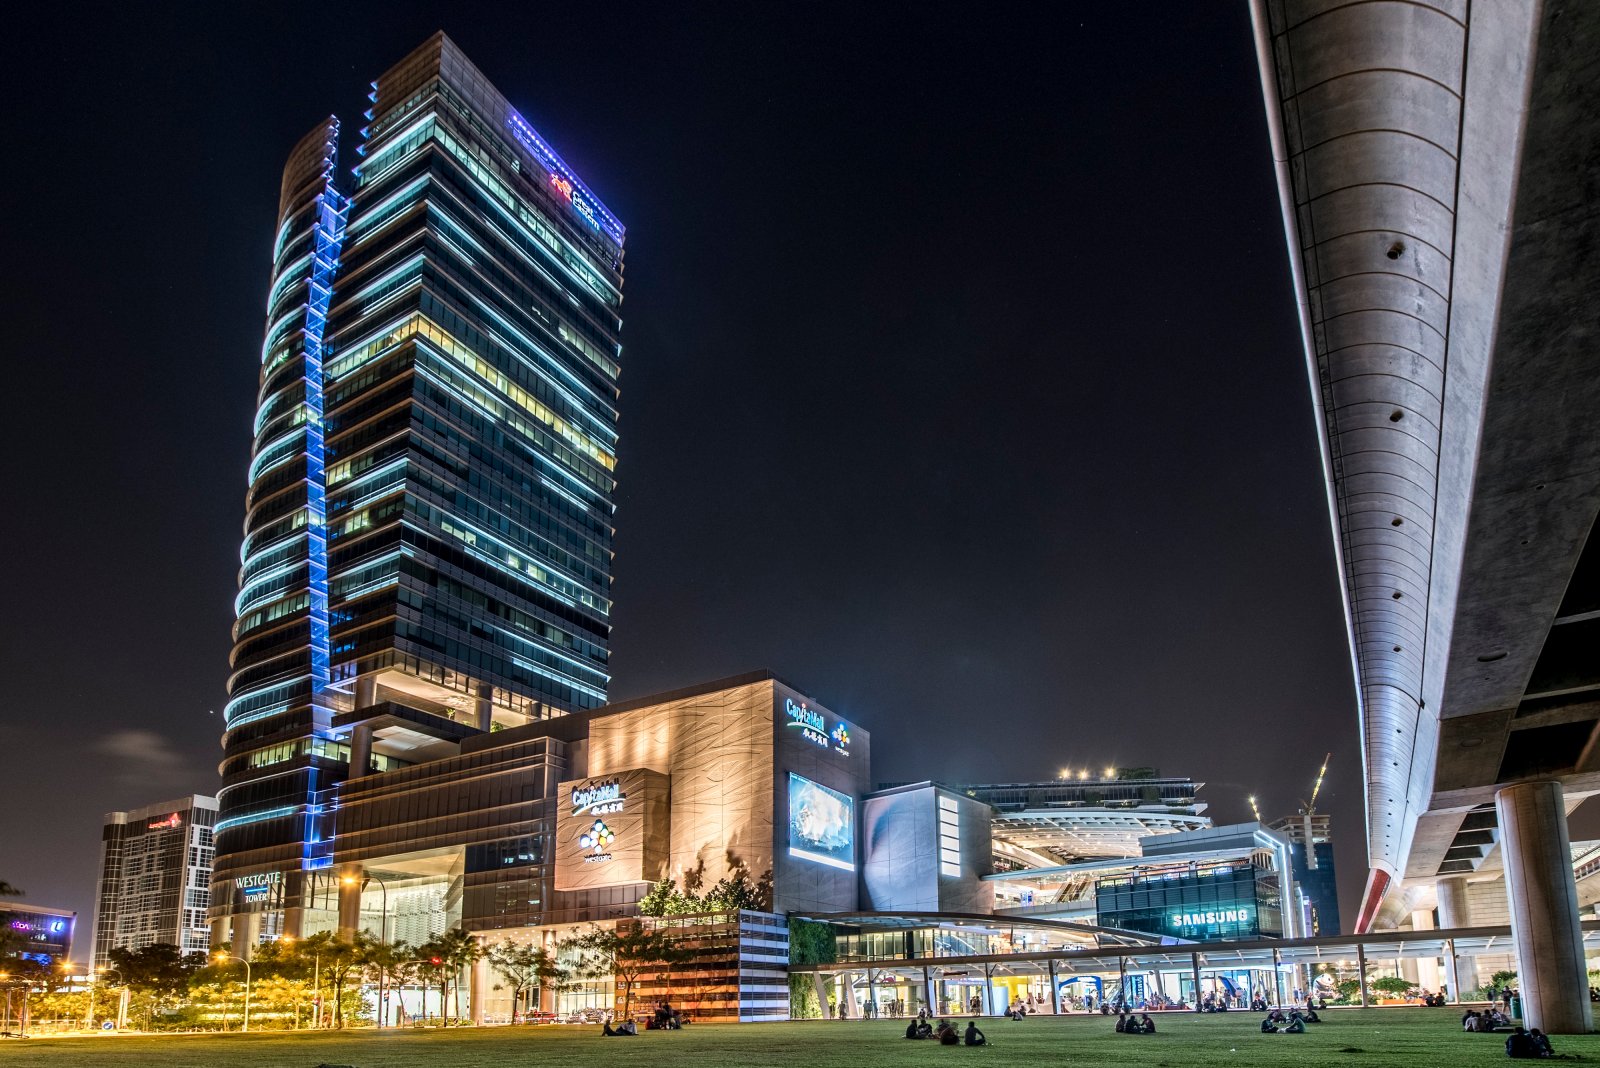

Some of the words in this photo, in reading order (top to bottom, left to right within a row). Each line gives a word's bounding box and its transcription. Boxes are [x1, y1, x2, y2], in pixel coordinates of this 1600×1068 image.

[573, 191, 593, 217] Great
[573, 197, 599, 230] Eastern
[787, 699, 824, 731] CapitaMall
[572, 784, 620, 806] CapitaMall
[585, 854, 612, 863] westgate
[235, 871, 281, 889] WESTGATE
[245, 893, 268, 903] TOWER
[1173, 909, 1248, 927] SAMSUNG
